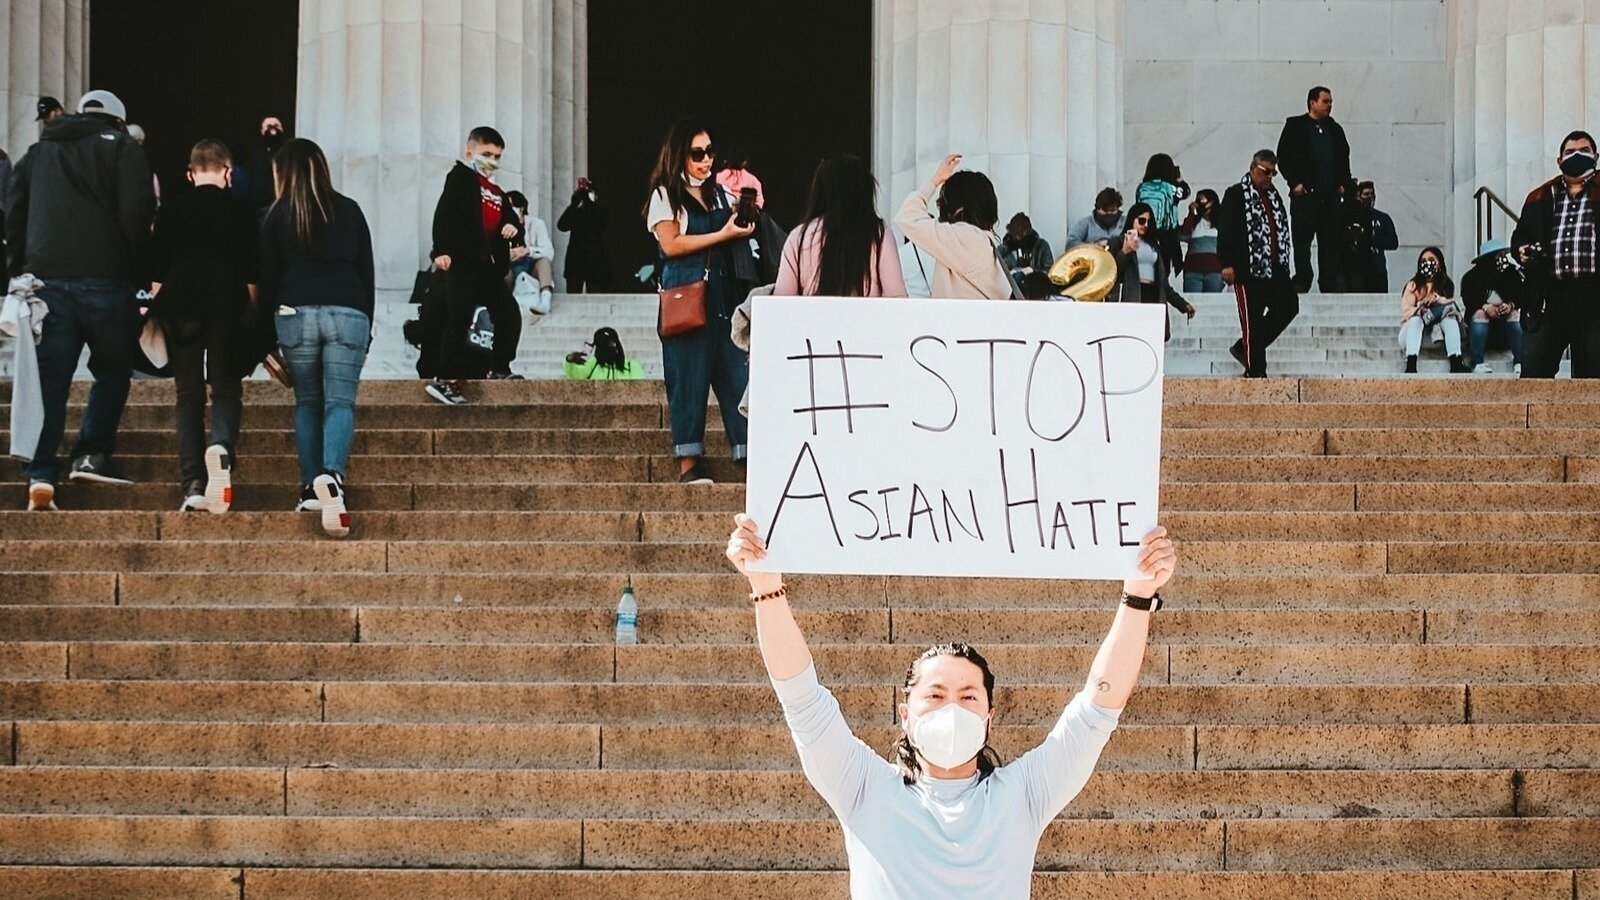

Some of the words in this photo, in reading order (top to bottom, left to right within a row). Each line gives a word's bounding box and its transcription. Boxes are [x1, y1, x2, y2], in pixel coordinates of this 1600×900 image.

[786, 334, 1159, 443] #STOP
[765, 441, 985, 550] ASIAN
[999, 448, 1141, 554] HATE
